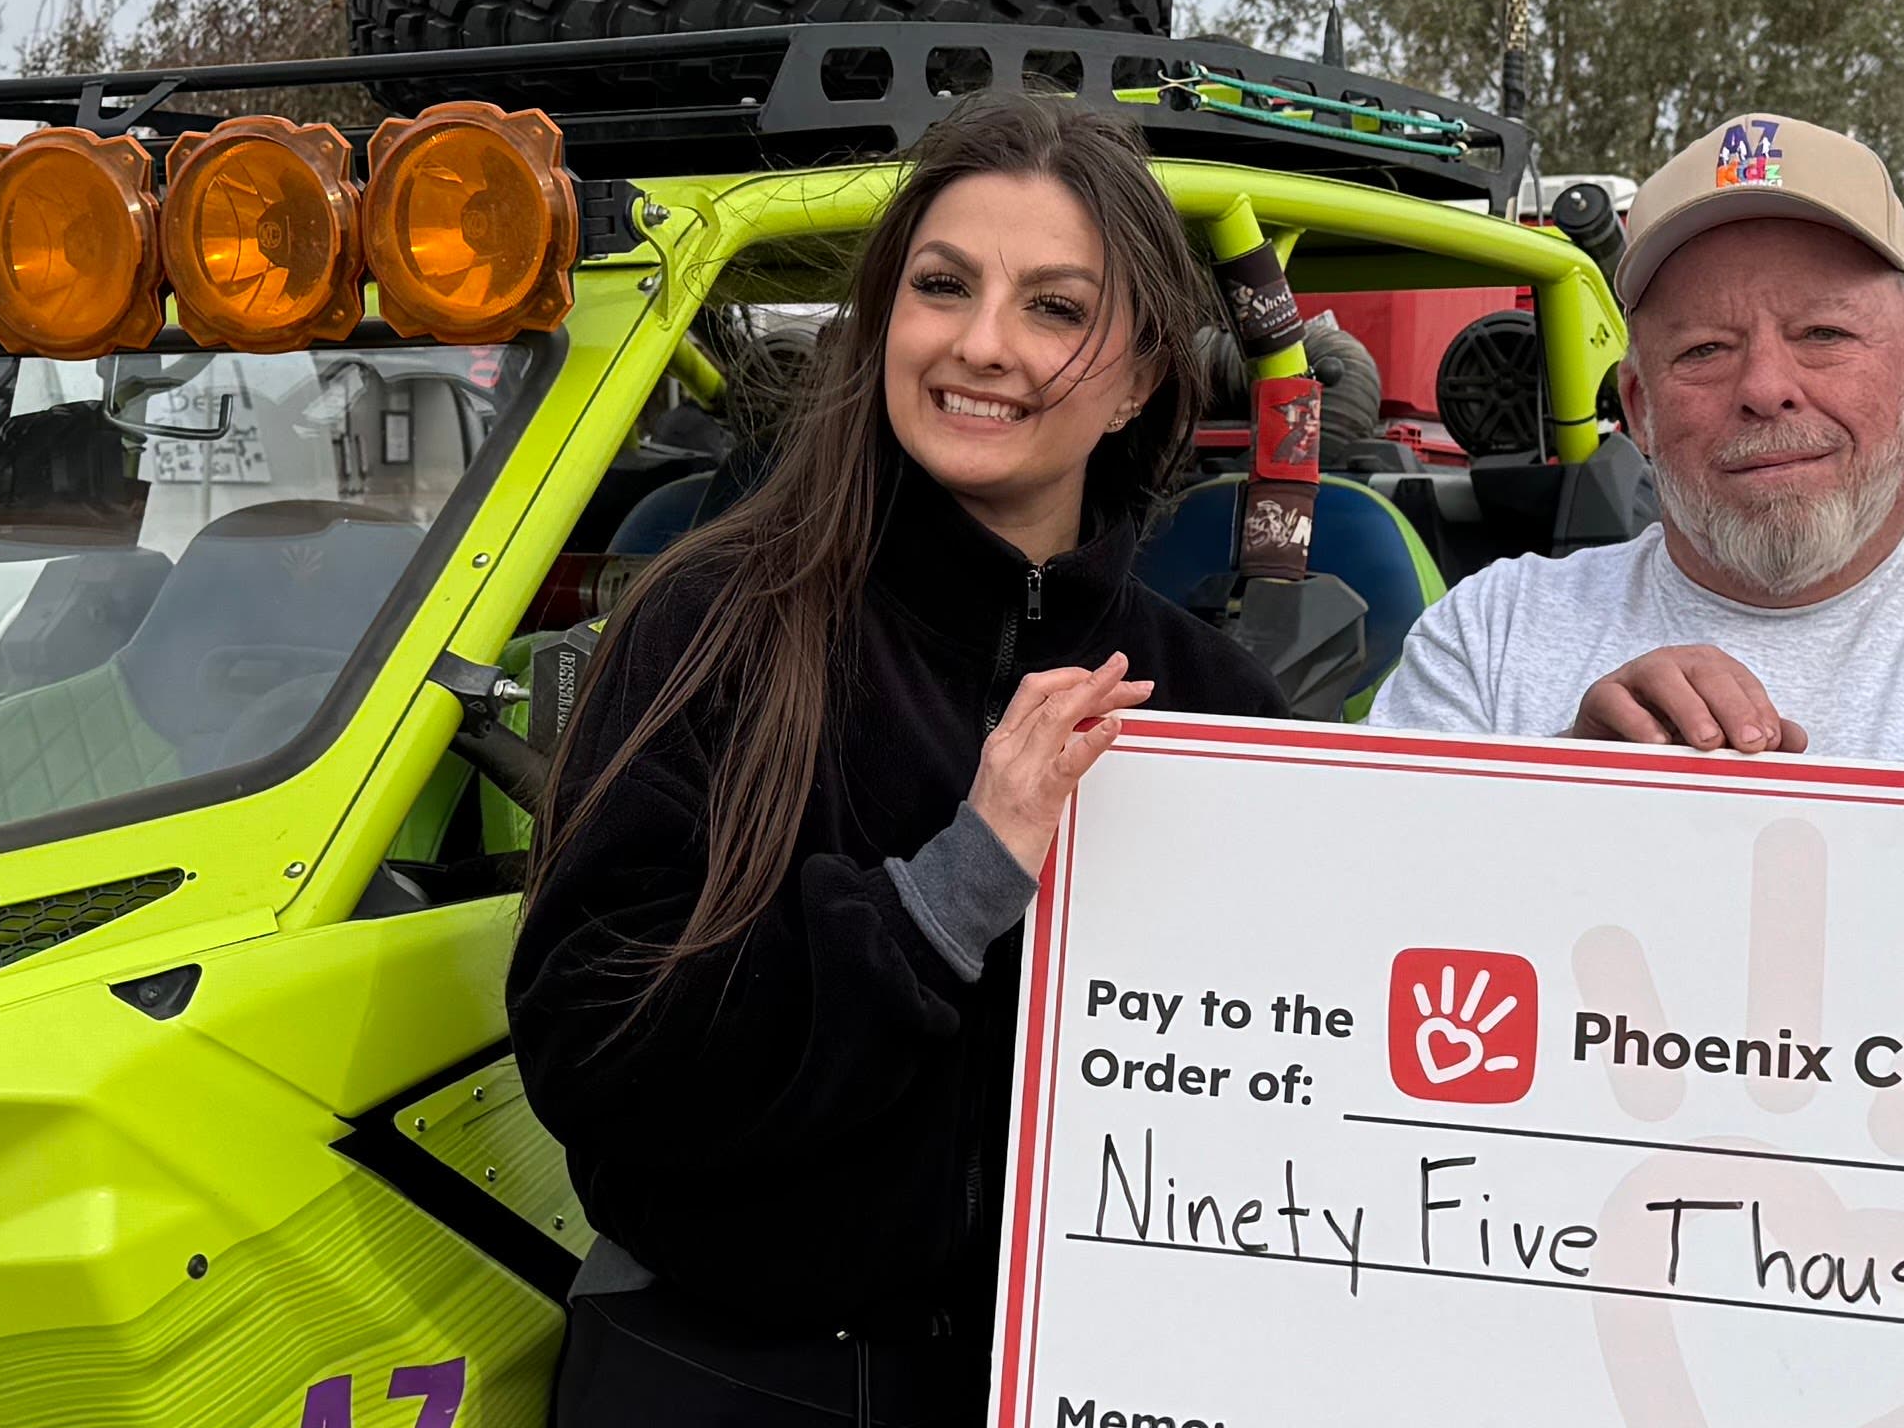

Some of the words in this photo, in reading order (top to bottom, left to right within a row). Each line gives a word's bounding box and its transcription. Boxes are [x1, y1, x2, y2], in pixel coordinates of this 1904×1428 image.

[1718, 120, 1782, 166] AZ
[1252, 284, 1293, 320] Shoc
[1087, 979, 1183, 1035] Pay
[1200, 990, 1252, 1029] to
[1271, 993, 1354, 1038] the
[1573, 1011, 1833, 1083] Phoenix
[1081, 1048, 1232, 1098] Order
[1248, 1063, 1314, 1106] of:
[1096, 1127, 1364, 1297] Ninety
[1420, 1155, 1598, 1277] Five
